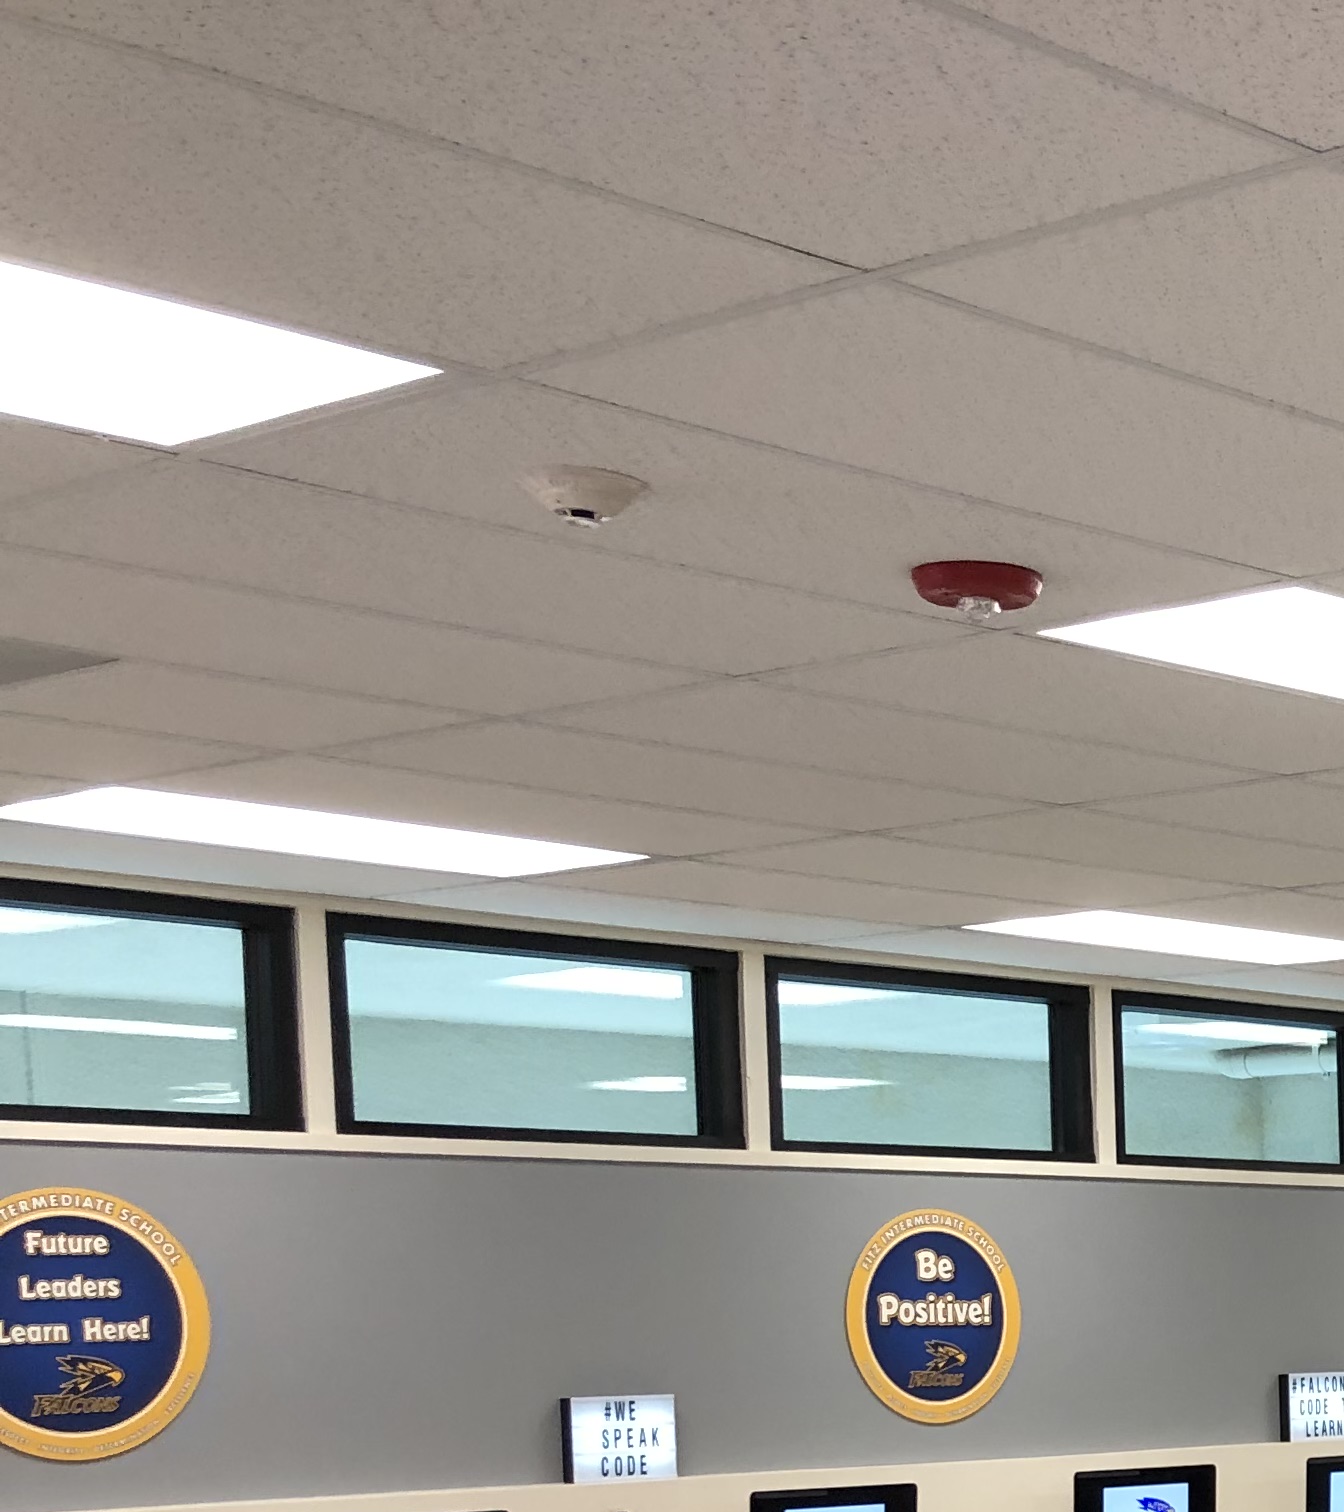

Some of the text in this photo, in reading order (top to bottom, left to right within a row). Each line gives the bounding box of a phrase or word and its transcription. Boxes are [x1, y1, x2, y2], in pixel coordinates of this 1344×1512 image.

[25, 1230, 110, 1255] Future
[119, 1208, 183, 1267] SCHOOL
[861, 1214, 1006, 1272] FITZ INTERMEDIATE SCHOOL
[915, 1248, 955, 1282] Be
[18, 1274, 121, 1300] Leaders
[878, 1292, 992, 1326] Positive!
[0, 1315, 150, 1345] Learn Here!
[31, 1395, 122, 1417] FALCONS
[604, 1400, 636, 1421] #WE
[1300, 1398, 1328, 1415] CODE
[602, 1427, 660, 1449] SPEAK
[1306, 1420, 1343, 1437] LEARN
[601, 1455, 648, 1477] CODE
